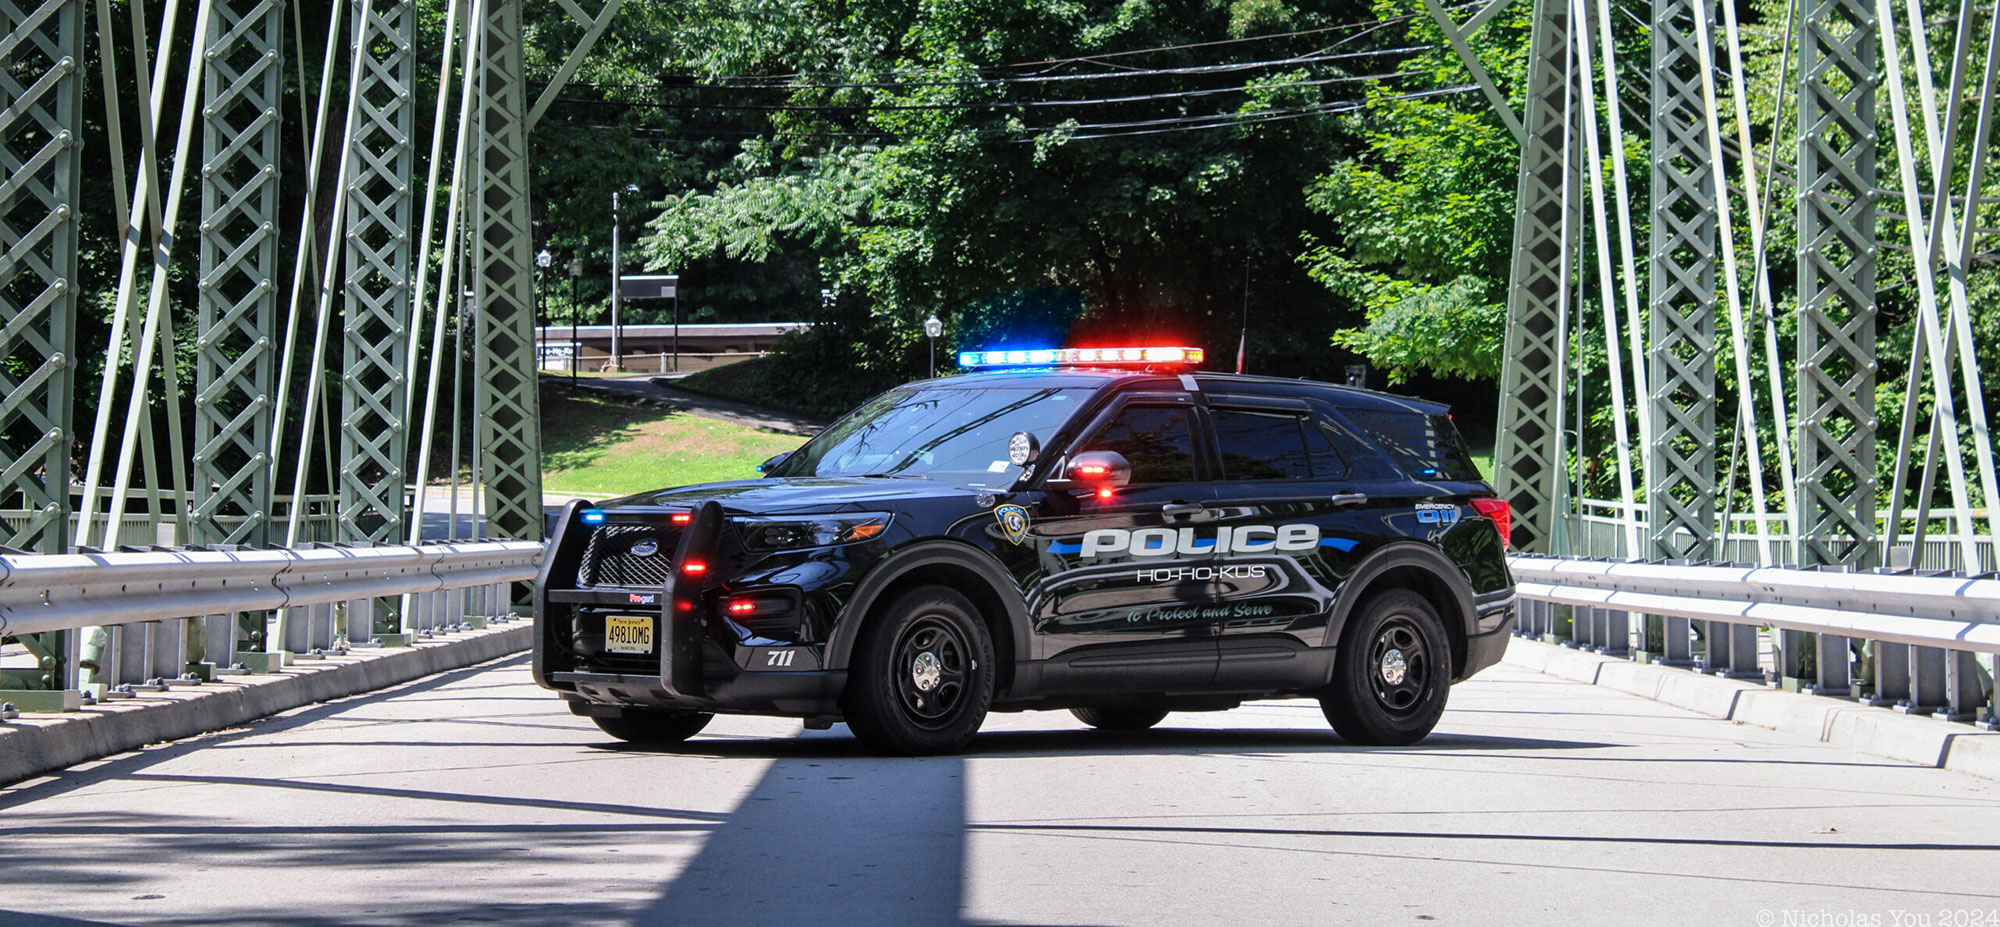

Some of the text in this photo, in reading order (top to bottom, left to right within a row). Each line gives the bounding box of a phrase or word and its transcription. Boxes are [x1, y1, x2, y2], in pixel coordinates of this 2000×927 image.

[998, 506, 1024, 516] POLICE
[1417, 510, 1457, 523] 911
[1079, 524, 1320, 558] POLICE
[1137, 566, 1265, 582] HO-HO-KUS
[1146, 605, 1200, 622] Protect
[1202, 604, 1230, 618] and
[1233, 602, 1273, 618] Serve
[609, 625, 649, 644] 49810MG
[768, 650, 795, 667] 711
